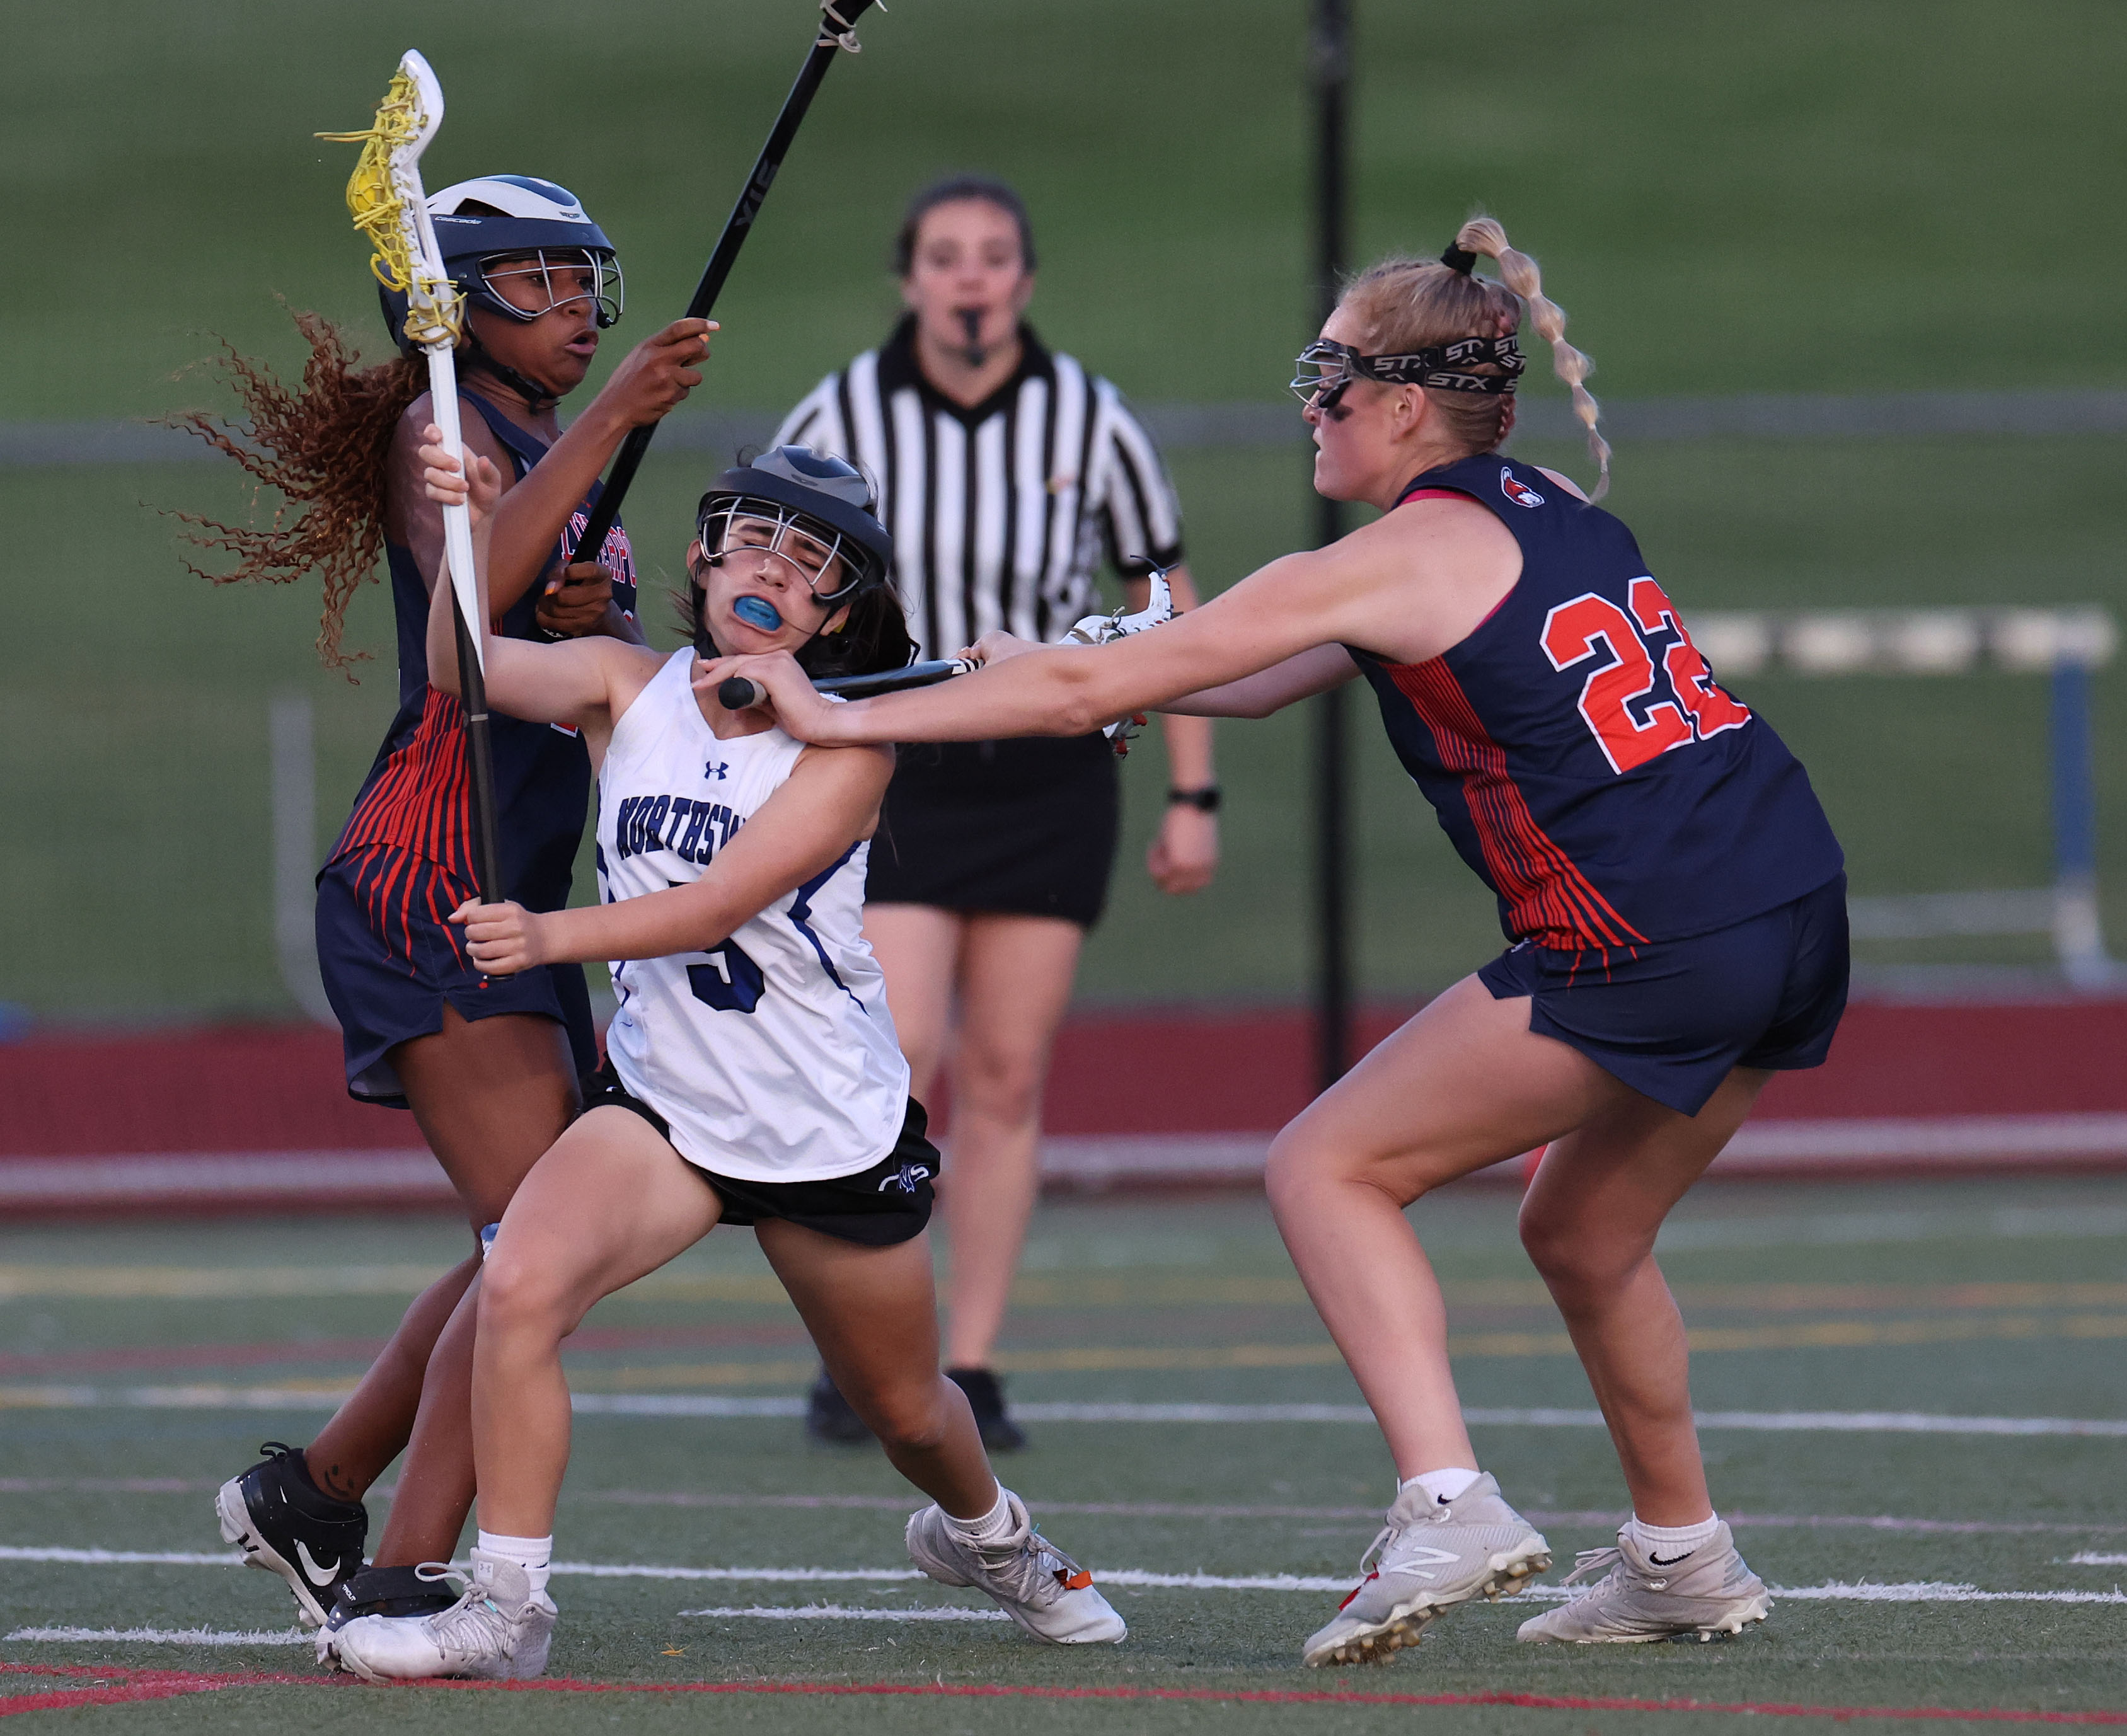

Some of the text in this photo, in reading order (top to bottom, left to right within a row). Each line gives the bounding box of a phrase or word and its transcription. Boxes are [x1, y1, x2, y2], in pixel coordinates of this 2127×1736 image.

[1427, 372, 1489, 391] STX
[1539, 576, 1752, 776] 22
[342, 1584, 356, 1601] TROUT
